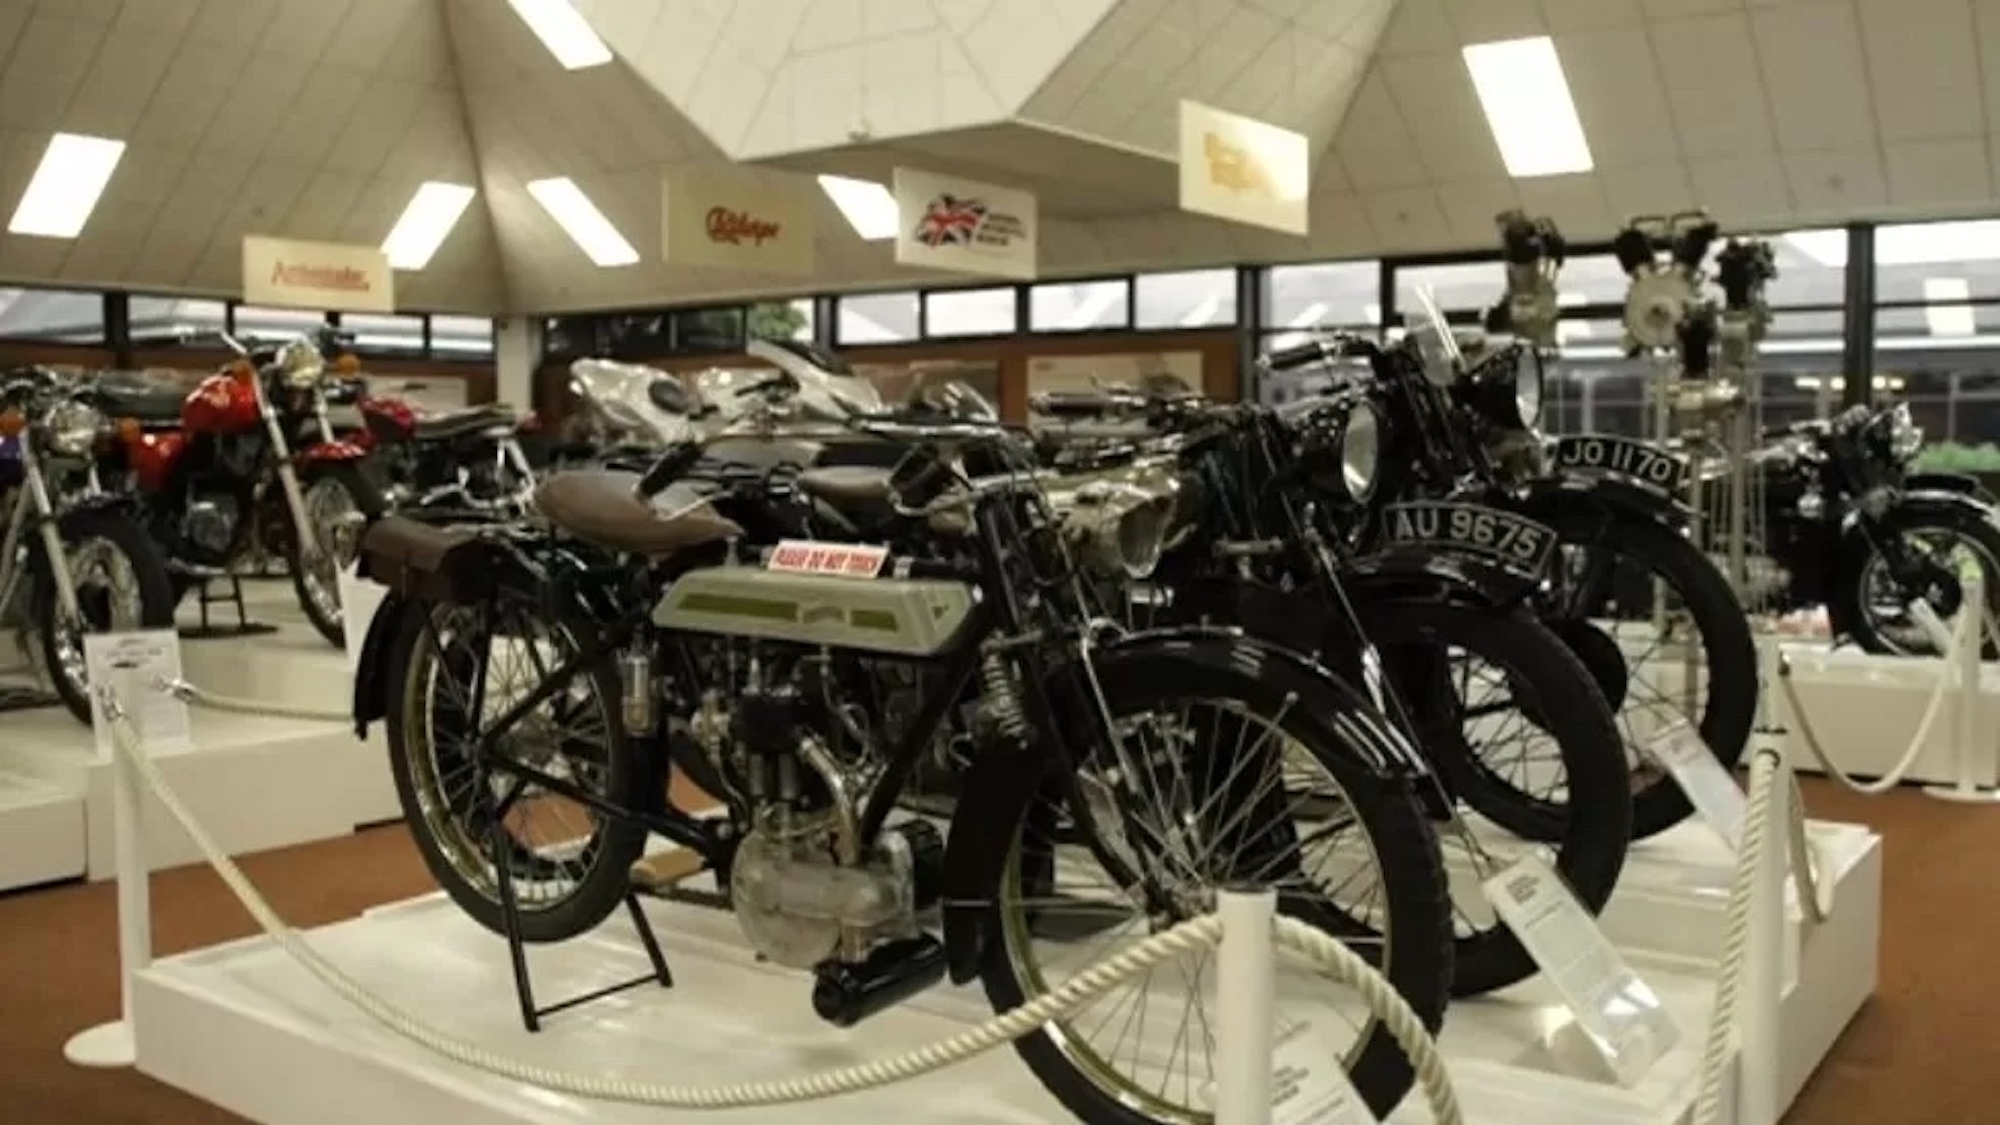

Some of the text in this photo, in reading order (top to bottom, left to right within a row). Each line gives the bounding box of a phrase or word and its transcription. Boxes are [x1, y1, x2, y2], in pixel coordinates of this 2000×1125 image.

[1562, 440, 1672, 481] JO 1170
[1396, 508, 1542, 559] AU 9675
